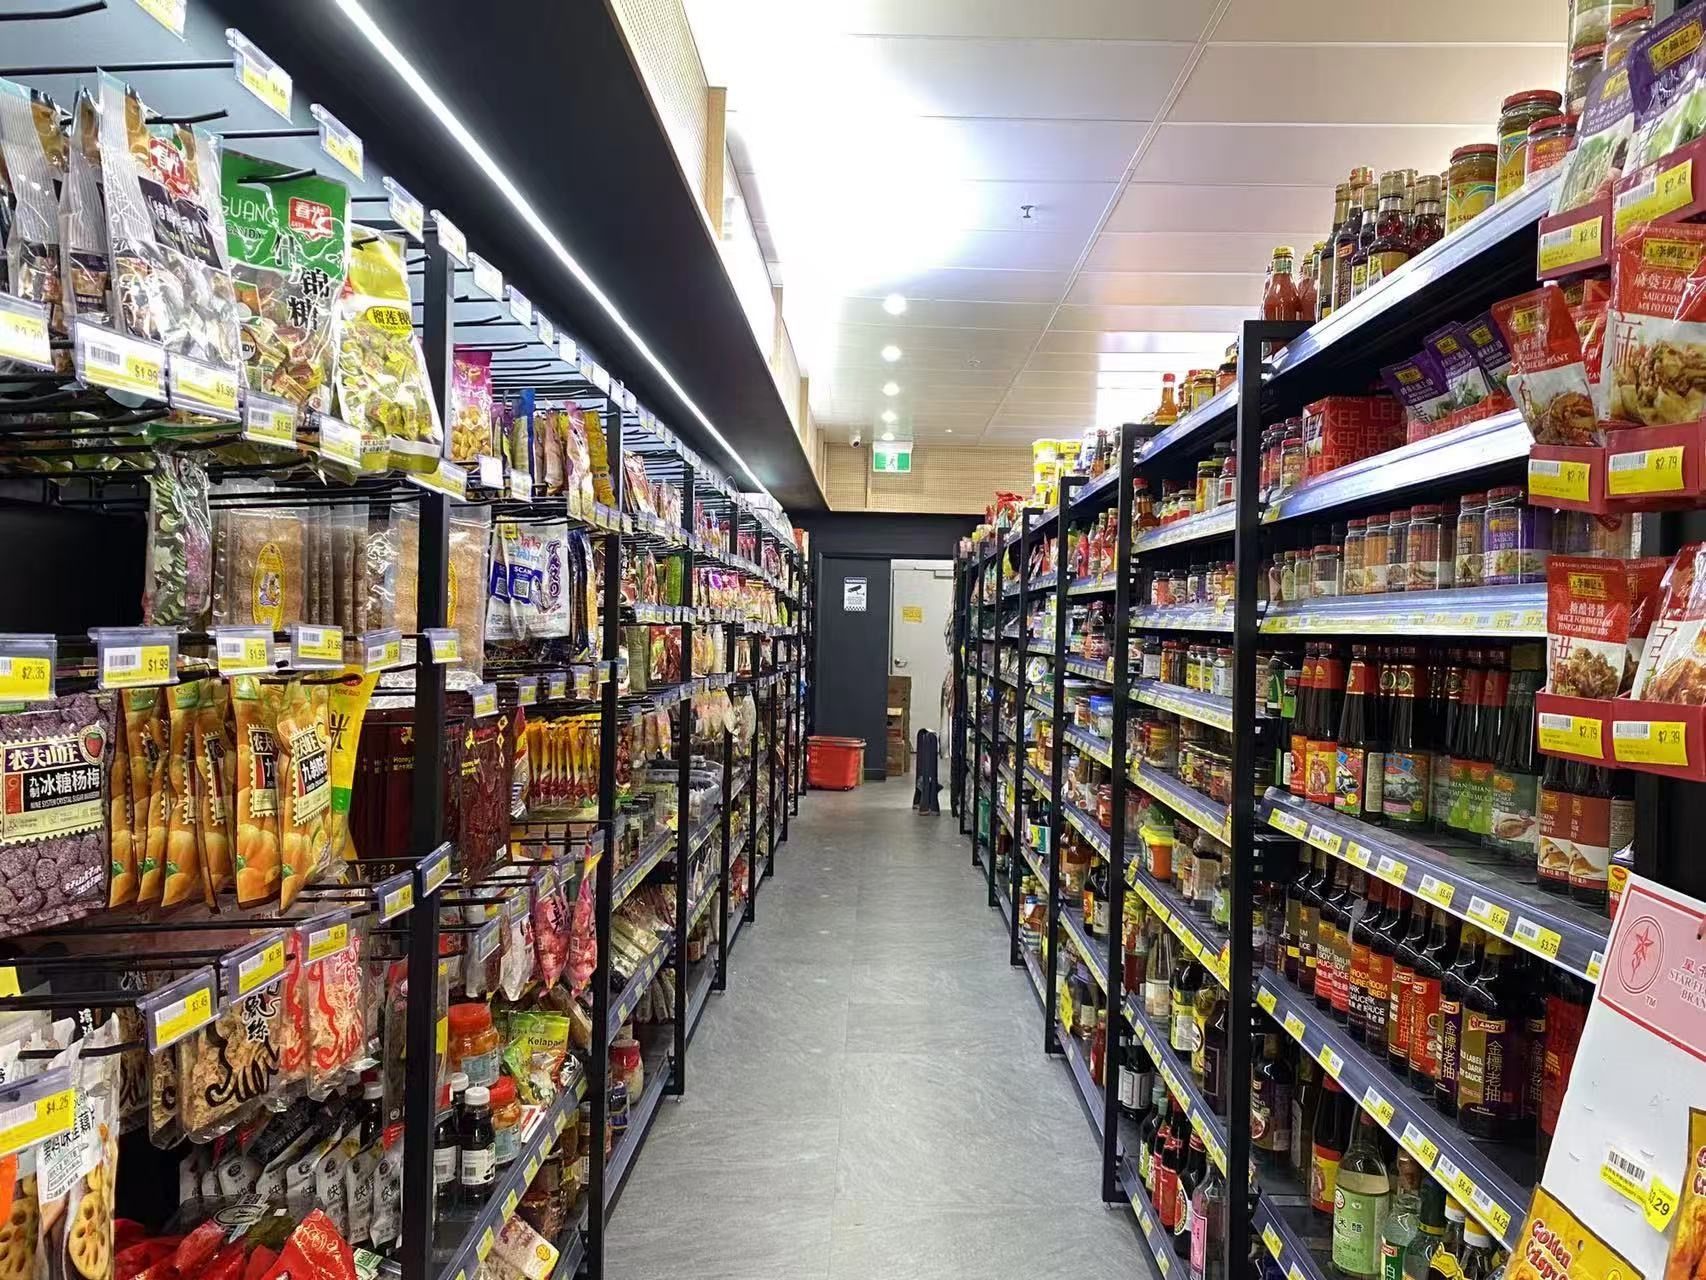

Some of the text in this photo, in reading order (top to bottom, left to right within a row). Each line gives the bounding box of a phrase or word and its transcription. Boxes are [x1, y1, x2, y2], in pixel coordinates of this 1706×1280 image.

[1656, 456, 1678, 470] $2.79
[1567, 470, 1585, 482] $2.79
[22, 666, 46, 681] $2.35
[148, 659, 169, 674] $1.99
[1579, 725, 1598, 740] $2.79
[39, 768, 100, 796] 冰糖杨梅
[1541, 938, 1557, 954] $3.79
[1479, 1022, 1500, 1030] AMOY
[1466, 1053, 1484, 1066] LABEL
[1467, 1062, 1483, 1075] DARK
[1485, 1040, 1503, 1102] 金標老抽
[46, 1096, 70, 1117] $4.25
[1531, 1218, 1573, 1270] Golden
